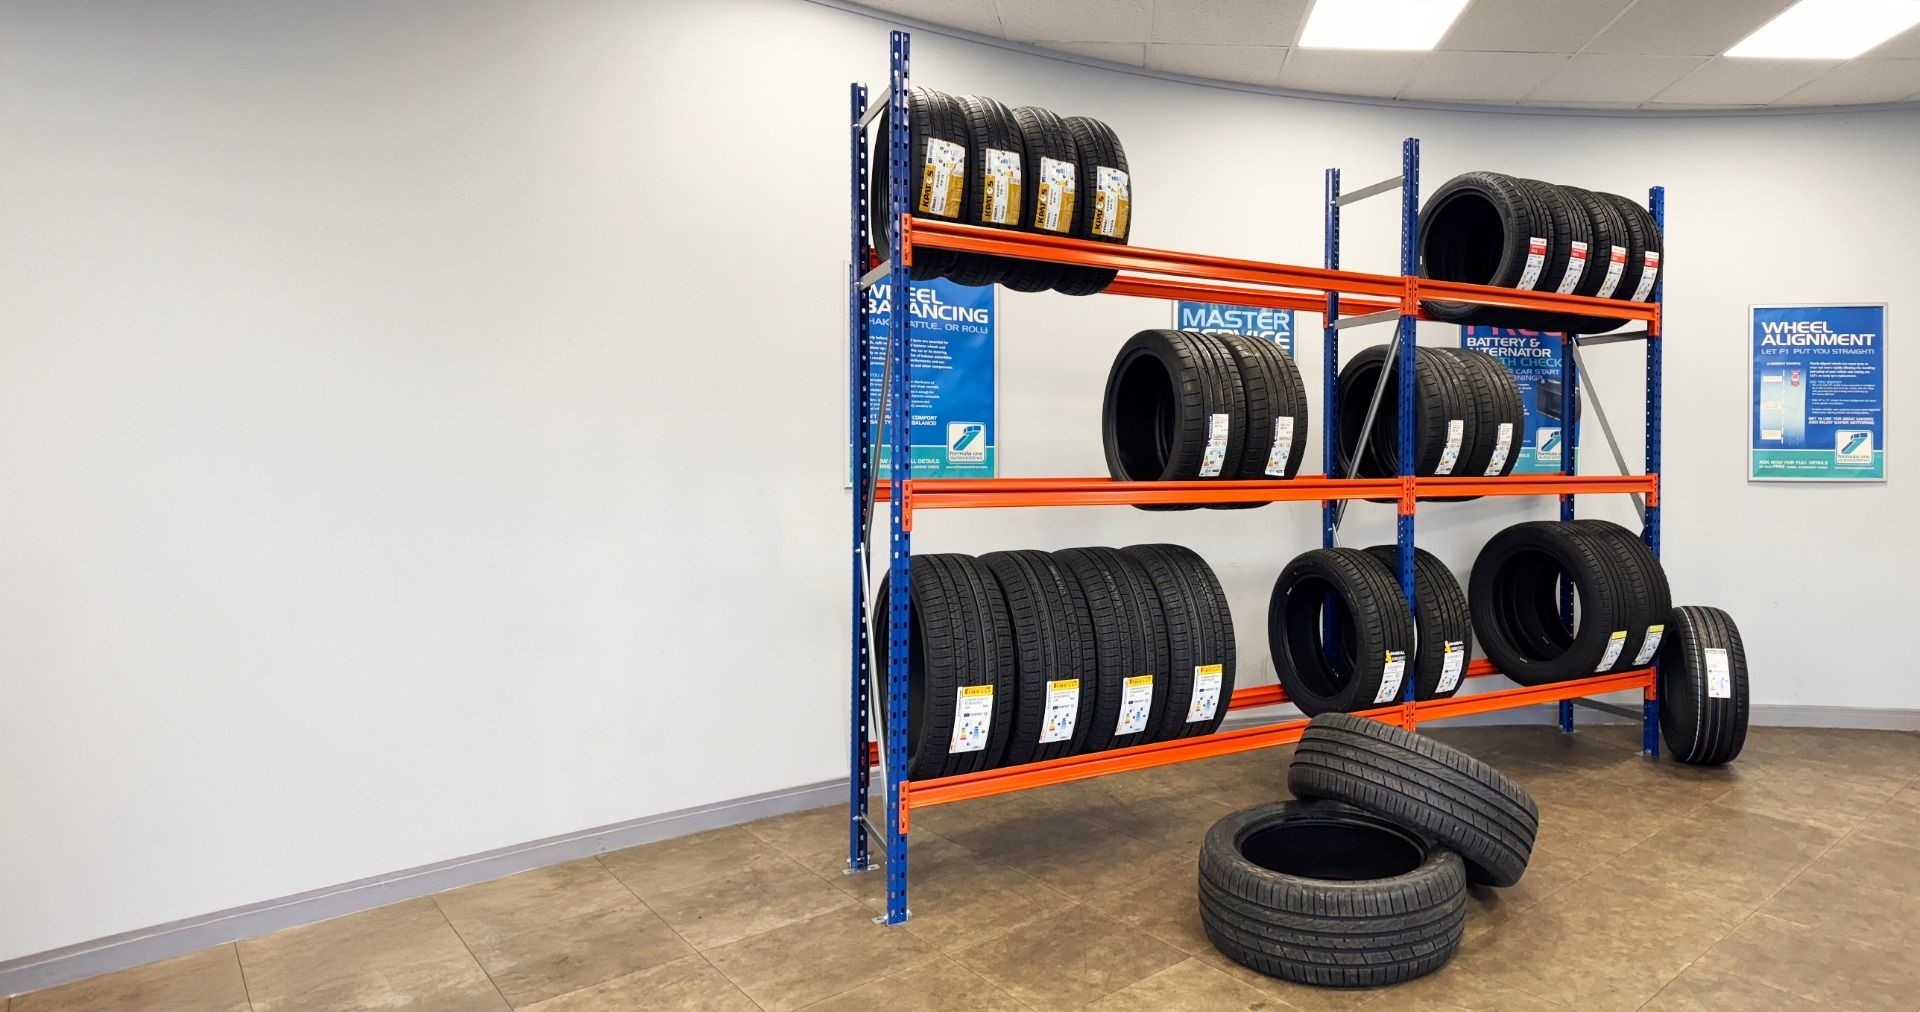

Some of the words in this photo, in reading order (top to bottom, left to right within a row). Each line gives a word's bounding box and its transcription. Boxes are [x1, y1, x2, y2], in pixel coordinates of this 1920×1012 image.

[869, 284, 943, 305] WEL
[869, 298, 989, 324] BAANCING
[1183, 308, 1290, 330] MASTER
[945, 323, 959, 332] OR
[1762, 321, 1833, 333] WHEEL
[1467, 337, 1526, 347] BATTERY
[1530, 338, 1540, 347] &
[1761, 334, 1876, 346] ALIGNMENT
[1469, 347, 1551, 358] TERNATOR
